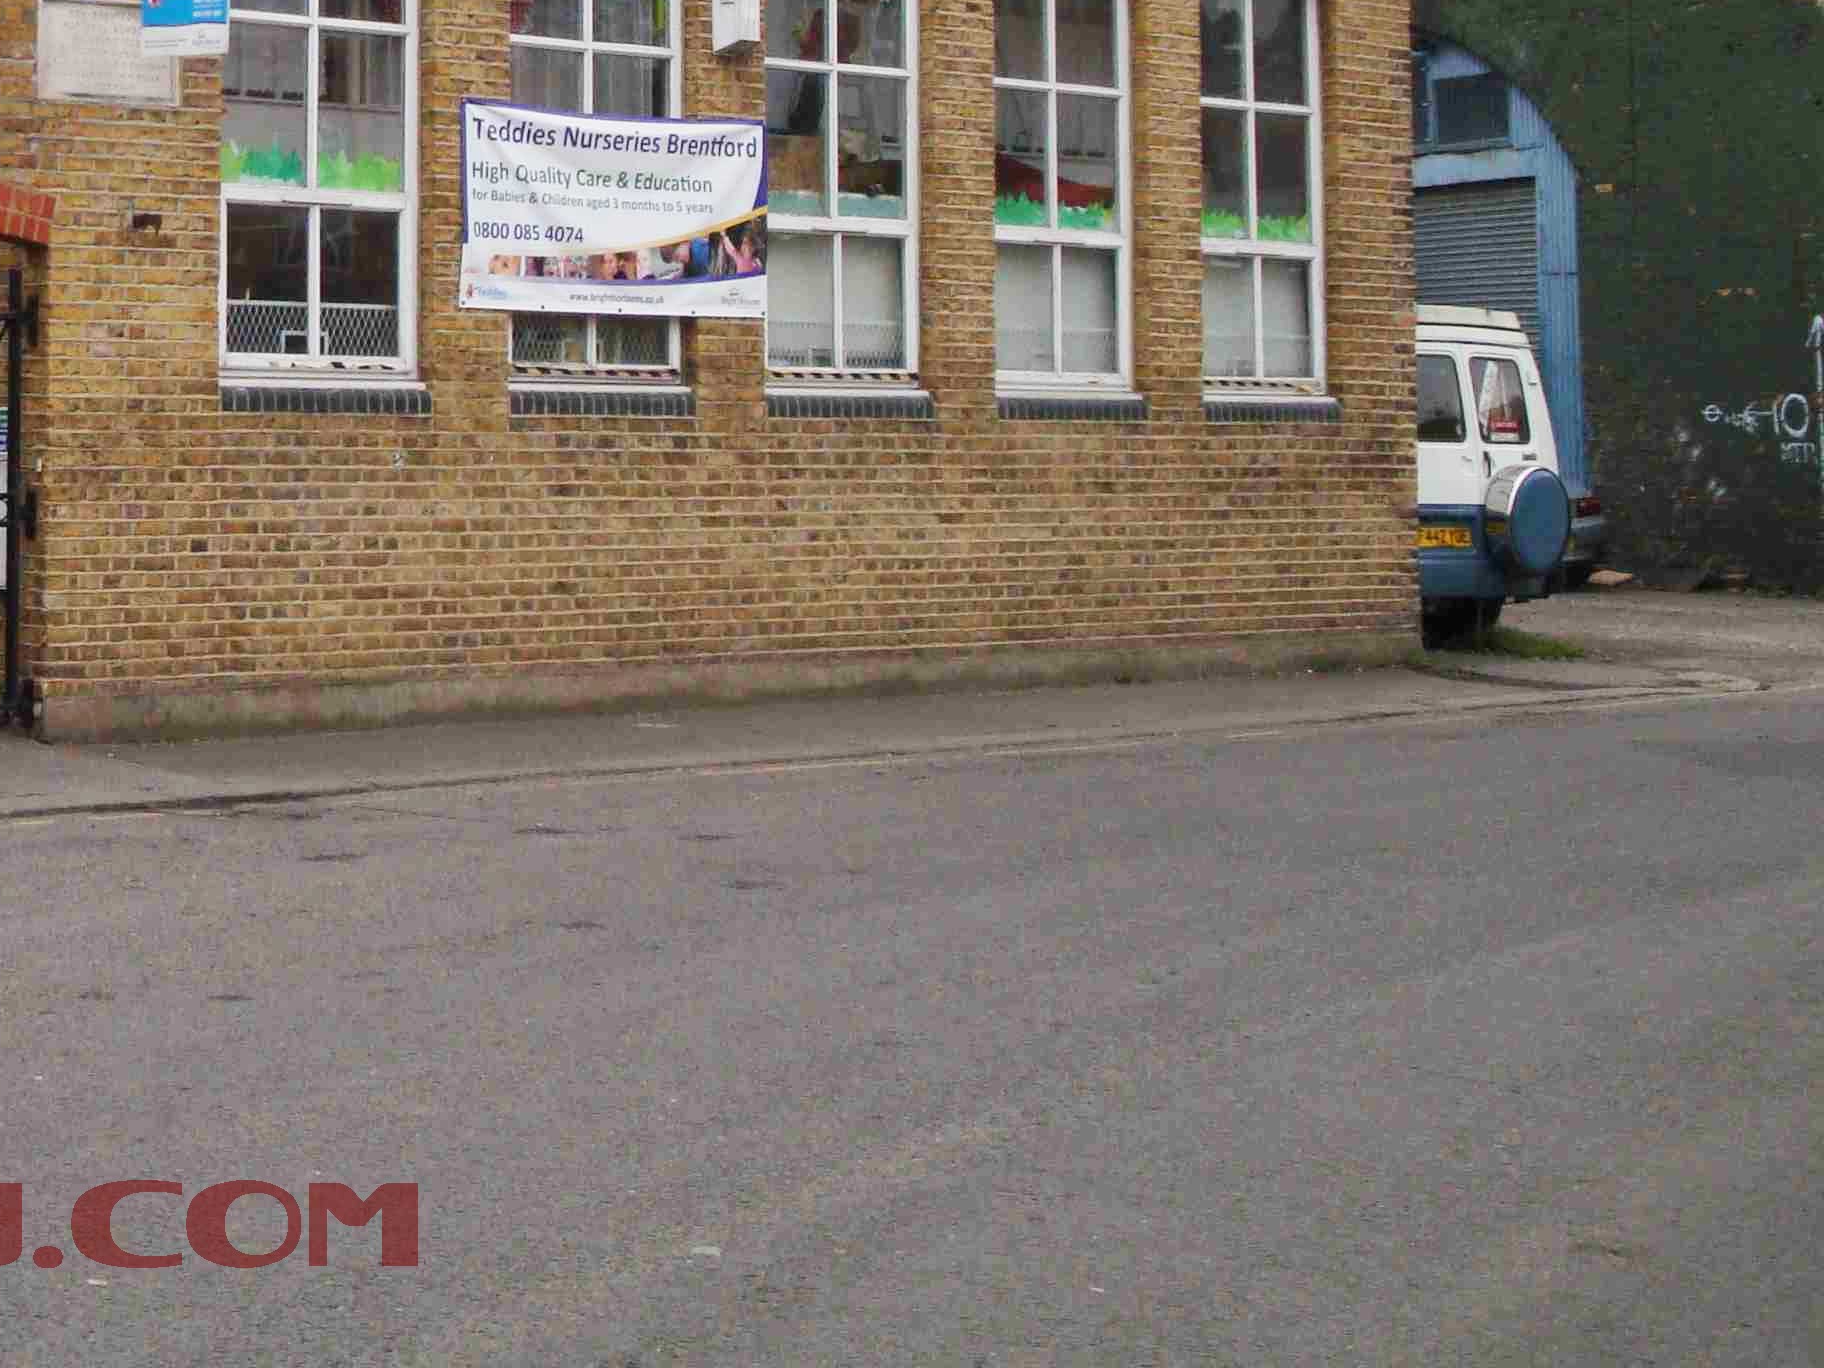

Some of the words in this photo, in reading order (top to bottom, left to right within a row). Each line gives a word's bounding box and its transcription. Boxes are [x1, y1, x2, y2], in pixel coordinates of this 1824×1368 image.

[473, 117, 557, 146] Teddies
[563, 126, 661, 153] Nurseries
[667, 134, 757, 158] Brentford
[472, 161, 509, 184] High
[516, 164, 572, 189] Quality
[576, 169, 612, 188] Care
[616, 171, 629, 189] &
[634, 172, 713, 193] Education
[472, 188, 487, 201] for
[491, 190, 526, 203] Babies
[529, 192, 539, 204] &
[542, 193, 584, 208] Children
[586, 196, 610, 211] aged
[612, 198, 619, 209] 3
[621, 199, 660, 212] months
[662, 201, 674, 212] to
[676, 201, 682, 212] 5
[686, 203, 714, 215] years
[473, 221, 509, 240] 0800
[514, 223, 540, 241] 085
[544, 225, 584, 243] 4074
